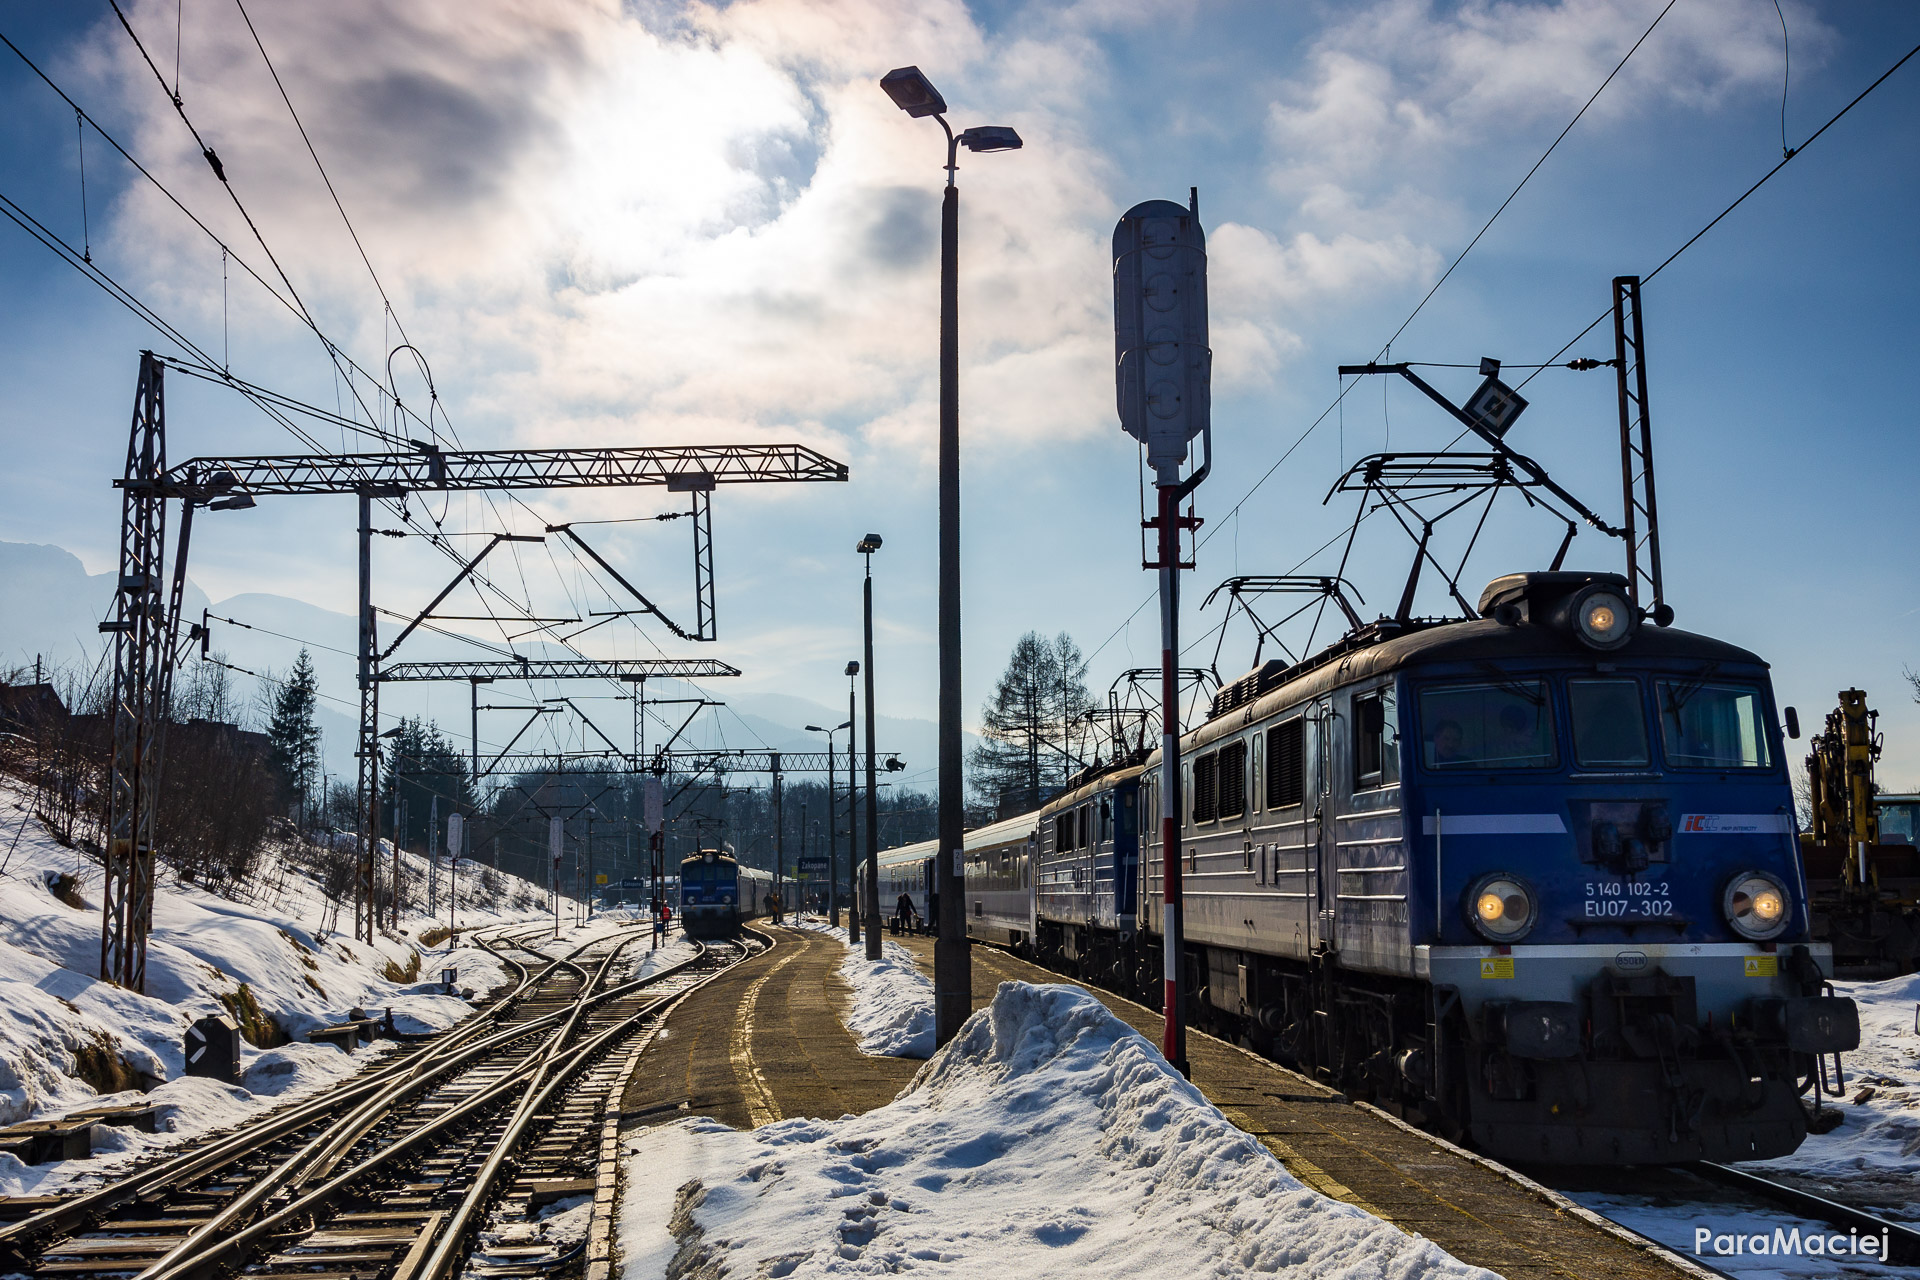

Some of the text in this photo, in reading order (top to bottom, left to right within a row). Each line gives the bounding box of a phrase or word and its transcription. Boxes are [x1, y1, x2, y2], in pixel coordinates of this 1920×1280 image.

[801, 861, 827, 870] Zakopane
[1586, 882, 1669, 896] 5 140 102-2
